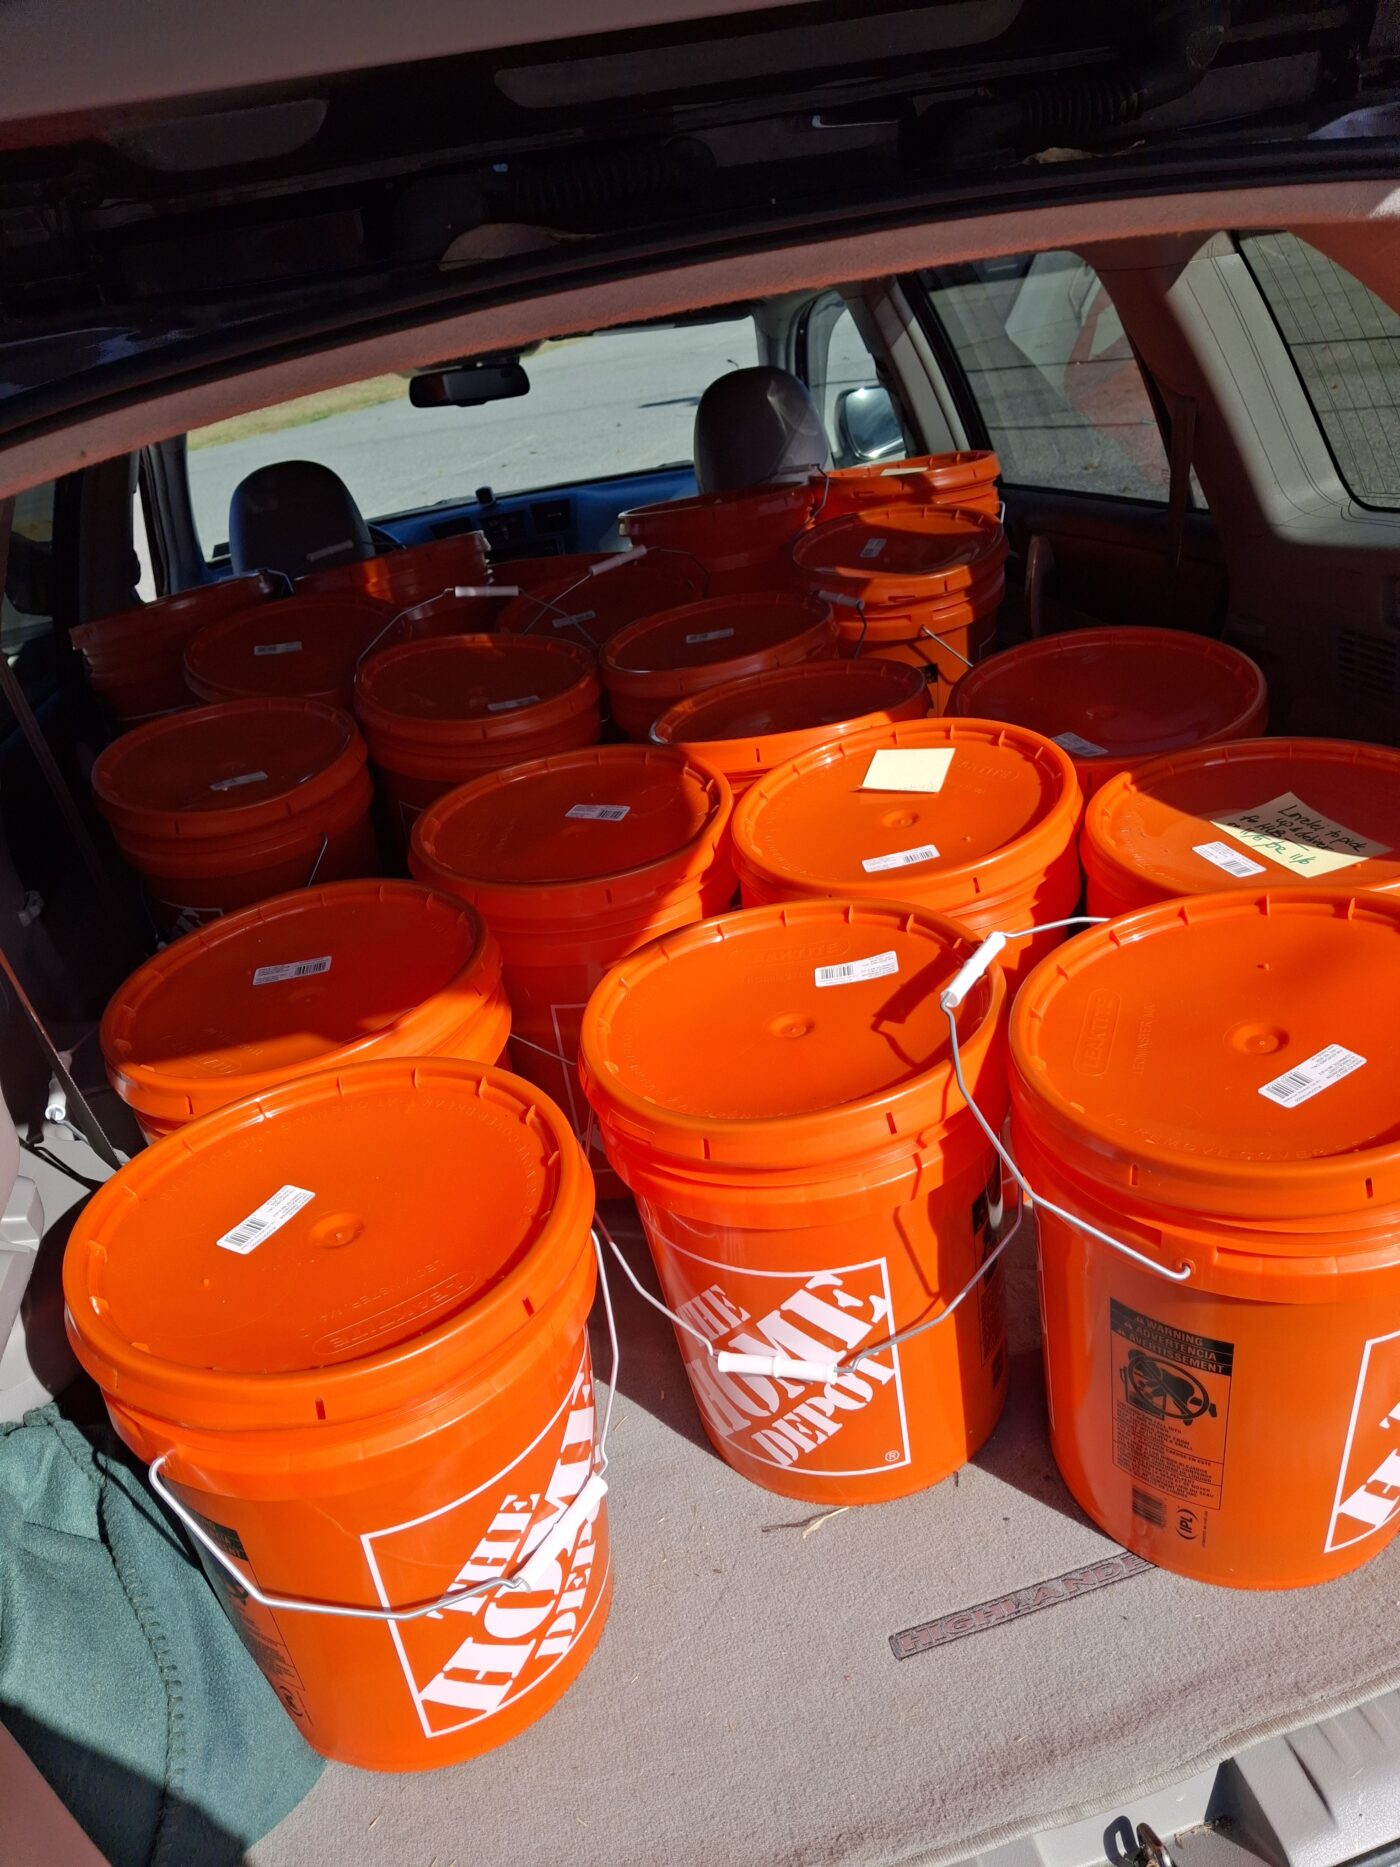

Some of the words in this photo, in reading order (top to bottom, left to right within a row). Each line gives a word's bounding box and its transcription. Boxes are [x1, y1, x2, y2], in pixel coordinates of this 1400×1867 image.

[1276, 817, 1294, 829] up
[1296, 828, 1335, 852] deliver
[1328, 827, 1341, 839] to
[1335, 836, 1368, 853] pick
[674, 1283, 751, 1346] THE
[1146, 1320, 1204, 1346] WARNING
[685, 1273, 889, 1437] HOME
[1128, 1333, 1225, 1373] AVERTISSEMENT
[1136, 1326, 1218, 1361] ADVERTENCIA
[425, 1493, 541, 1620] THE
[534, 1480, 600, 1660] DEP
[898, 1554, 1150, 1652] HIGHLANDE
